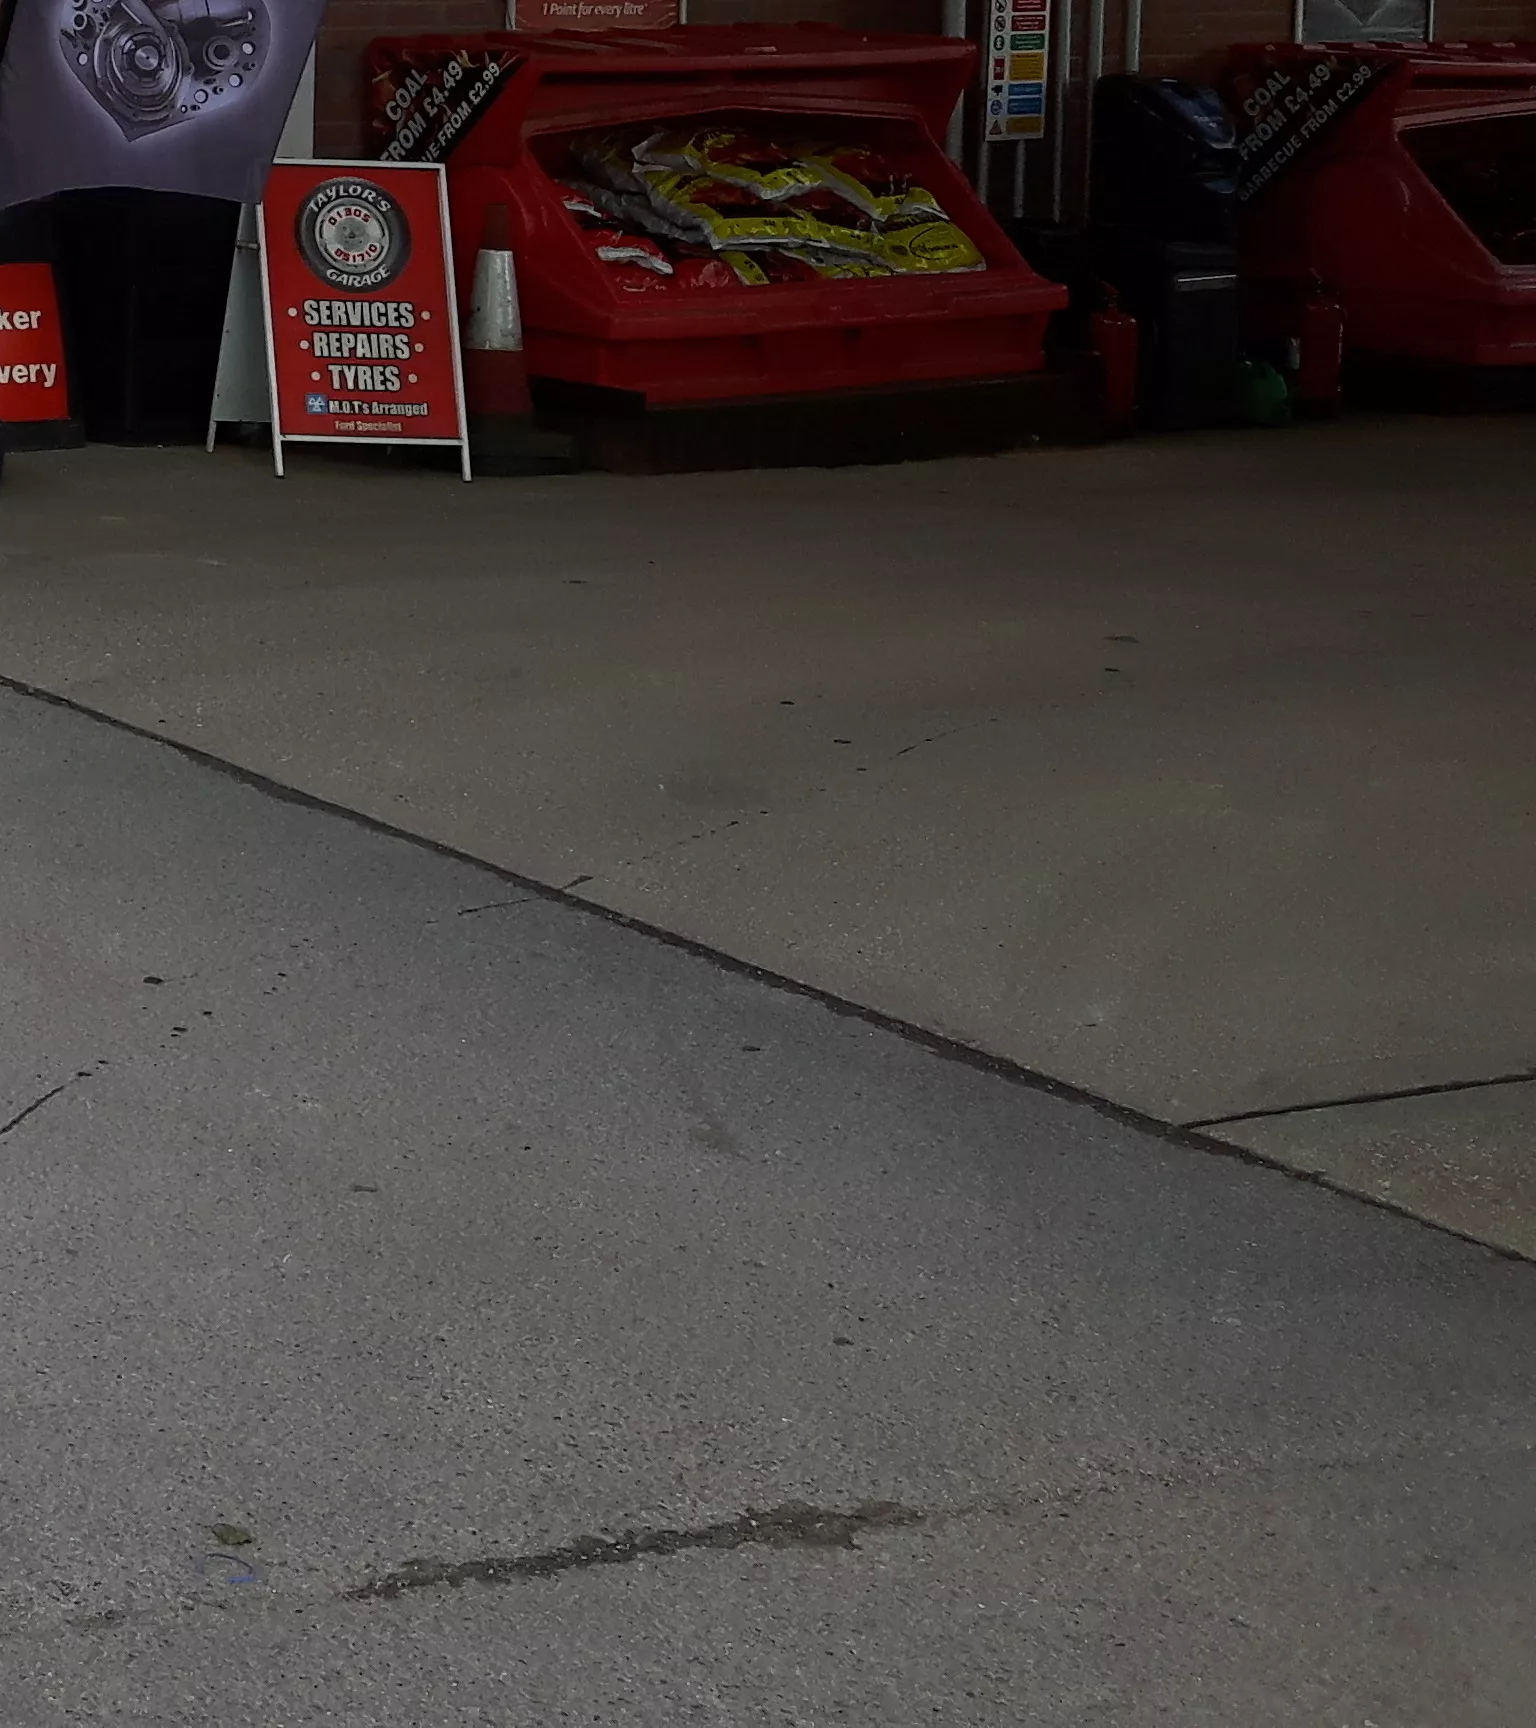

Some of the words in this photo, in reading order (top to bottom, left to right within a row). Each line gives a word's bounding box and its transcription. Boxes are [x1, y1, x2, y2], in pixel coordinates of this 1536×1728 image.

[549, 2, 577, 15] Point
[577, 2, 593, 18] for
[594, 5, 623, 18] every
[385, 69, 428, 121] COAL
[423, 61, 462, 117] £4.49
[468, 62, 500, 105] £2.99
[1243, 71, 1292, 116] COAL
[1336, 65, 1372, 102] £2.99
[1238, 108, 1287, 161] FROM
[1284, 64, 1331, 114] £4.49
[309, 184, 391, 212] TAYLOR'S
[328, 207, 371, 225] 01305
[326, 264, 391, 287] GARAGE
[303, 300, 415, 328] SERVICES
[312, 332, 410, 359] REPAIRS
[328, 365, 401, 391] TYRES
[372, 402, 428, 416] Arranged
